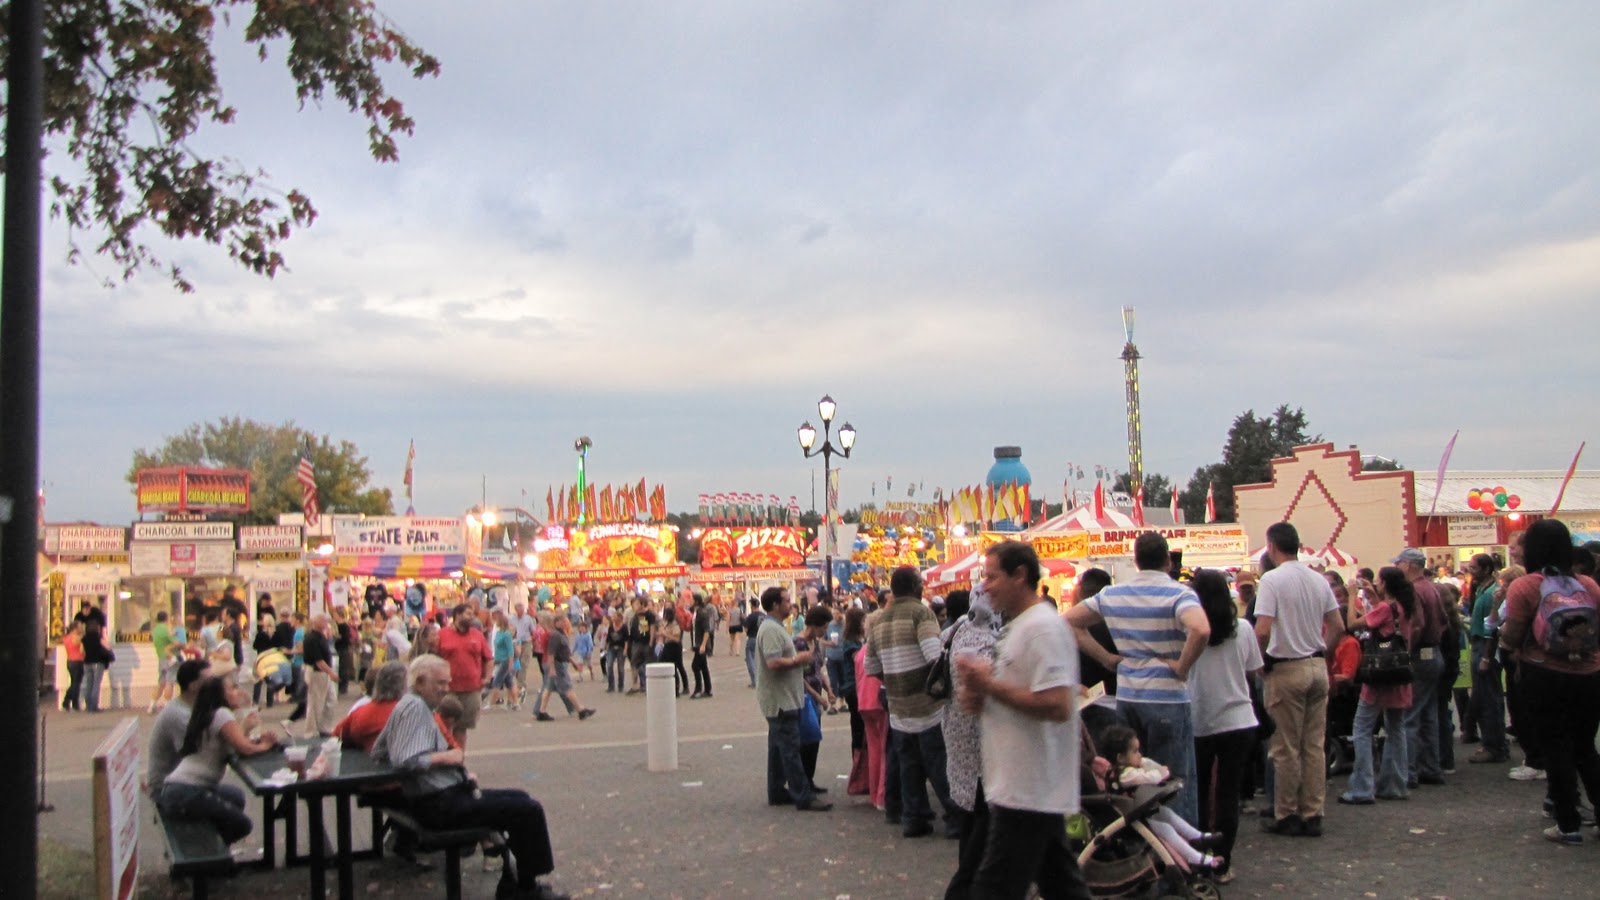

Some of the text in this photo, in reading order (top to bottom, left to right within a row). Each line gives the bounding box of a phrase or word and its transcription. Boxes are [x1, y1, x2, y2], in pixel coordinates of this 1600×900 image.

[61, 529, 124, 537] CHARBURGERS
[139, 526, 230, 536] CHARCOAL HEARTH
[1160, 529, 1187, 539] CAFE
[360, 528, 440, 545] STATE FAIR
[61, 541, 84, 550] FRIES
[94, 541, 123, 549] DRINKS
[246, 540, 295, 549] SANDWICH
[585, 569, 630, 578] FRIED DOUGH
[638, 568, 666, 576] ELEPHANT
